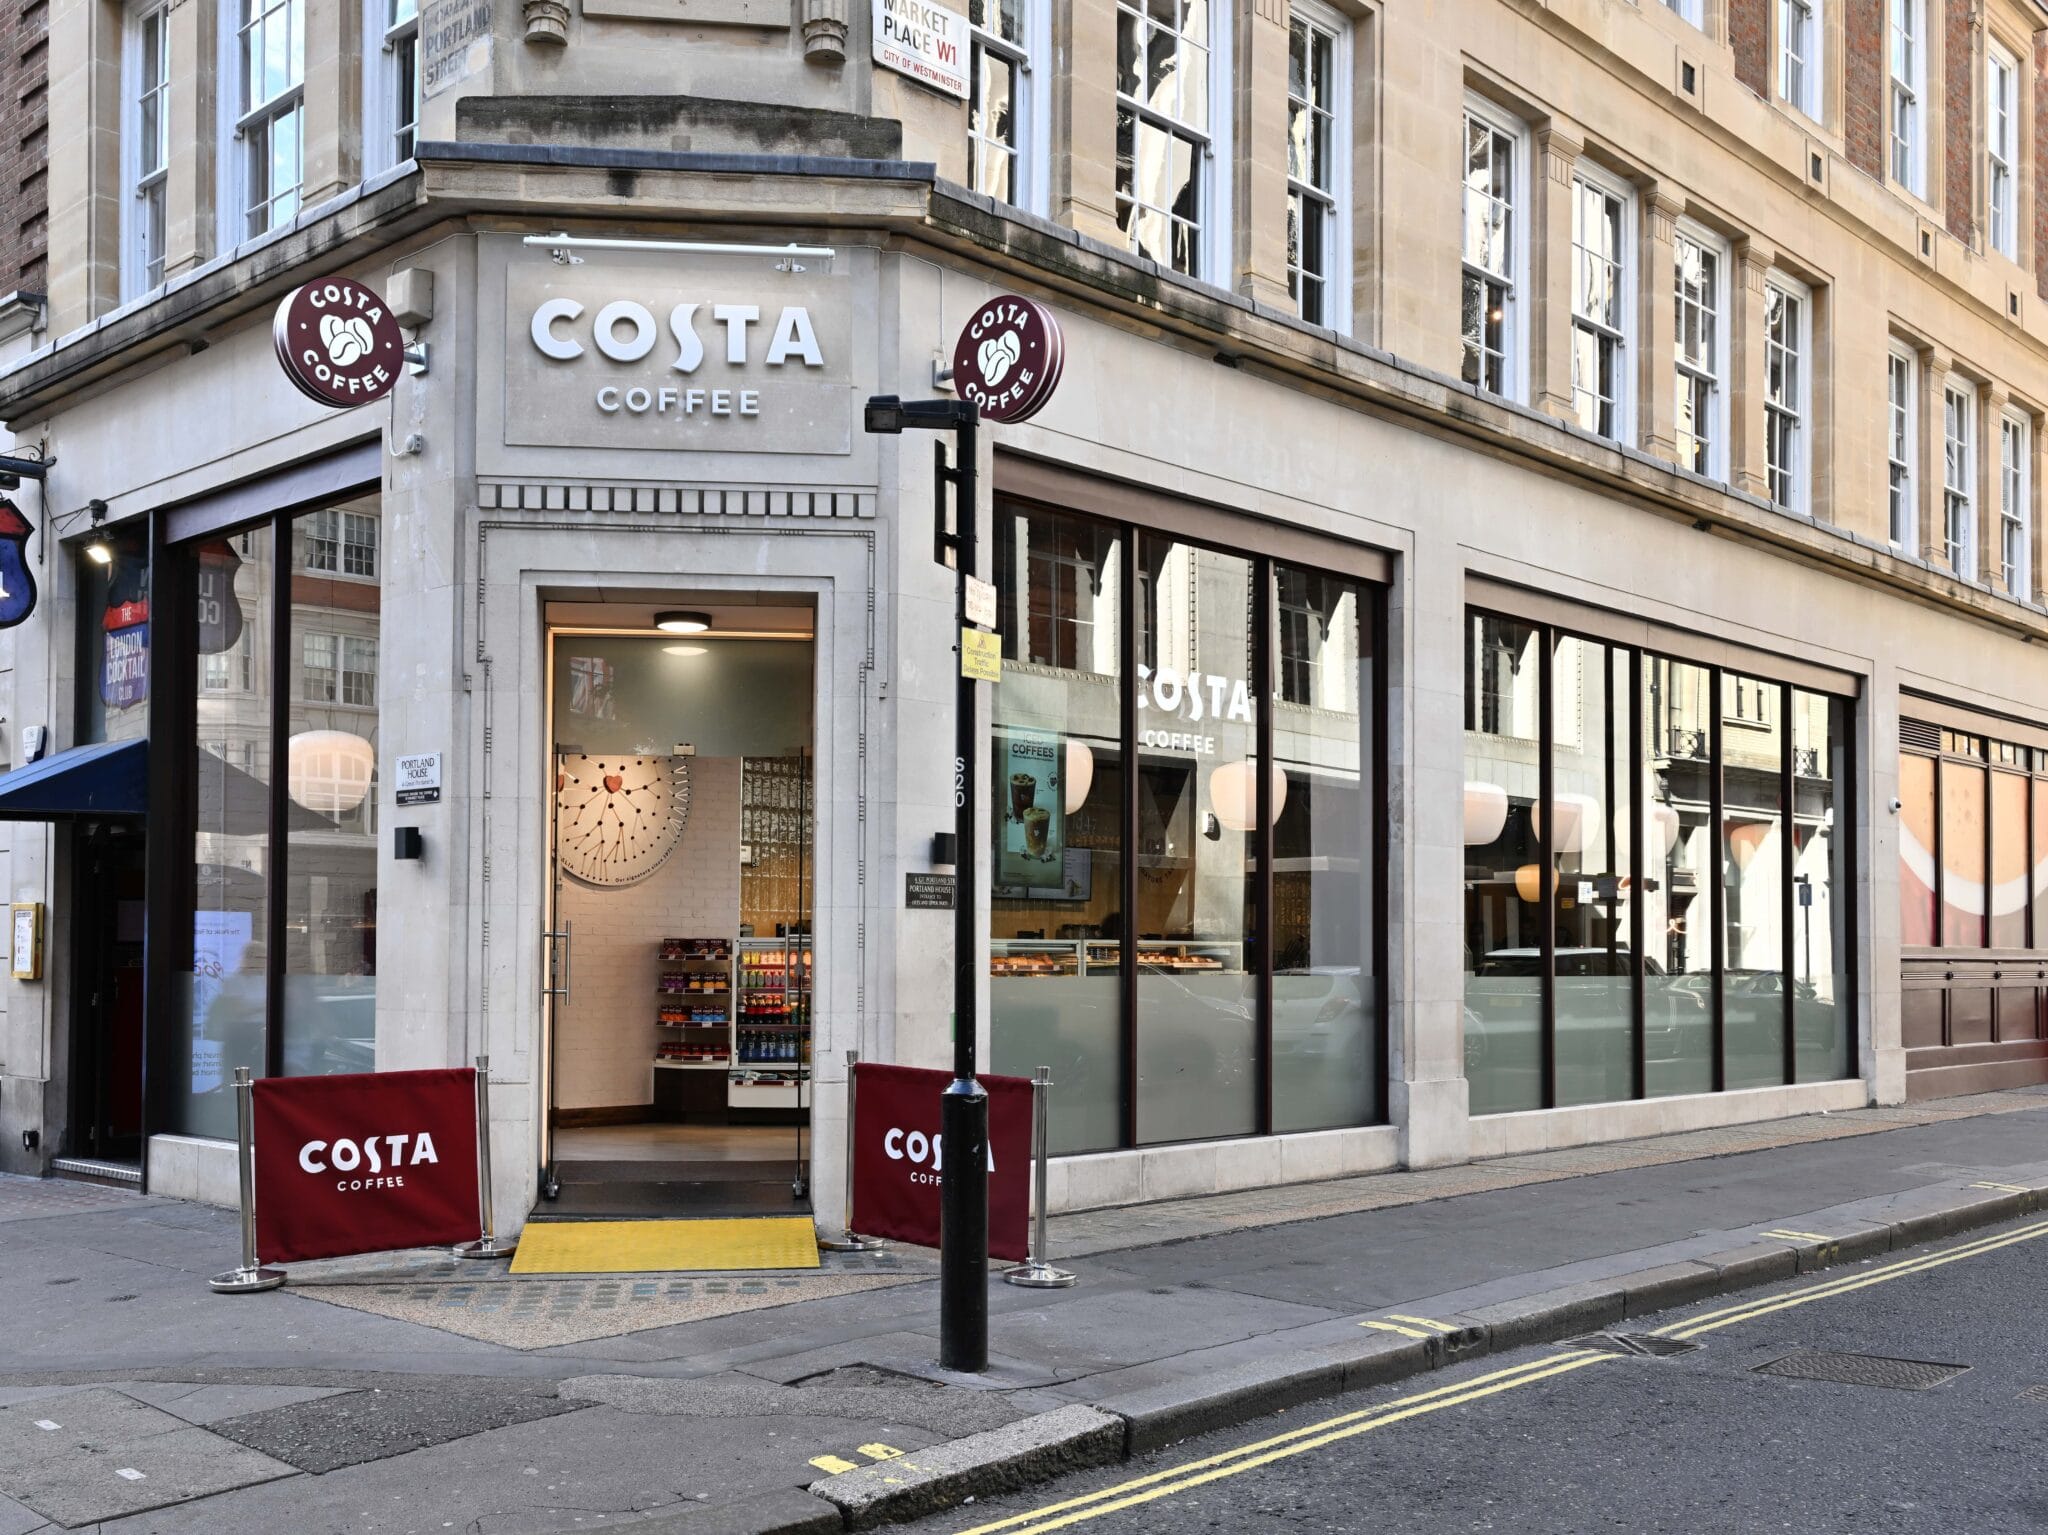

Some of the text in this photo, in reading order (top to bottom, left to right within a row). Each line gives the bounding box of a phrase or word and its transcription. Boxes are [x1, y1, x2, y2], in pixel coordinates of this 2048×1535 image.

[426, 4, 491, 58] PORTLAND
[884, 15, 957, 66] PLACE W1
[883, 49, 962, 92] CITY OF WESTMINSTER
[310, 284, 383, 325] COSTA
[531, 297, 825, 374] COSTA
[970, 303, 1029, 339] COSTA
[303, 349, 390, 395] COFFEE
[597, 386, 760, 414] COFFEE
[965, 368, 1034, 411] COFFEE
[121, 606, 132, 621] THE
[109, 630, 143, 659] LONDON
[106, 653, 145, 684] COCKTAIL
[118, 684, 132, 701] CLUB
[1012, 743, 1054, 758] COFFEES
[1145, 729, 1215, 754] COFFEE
[401, 757, 435, 770] PORTLAND
[407, 768, 428, 779] HOUSE
[910, 884, 935, 893] PORTLAND
[299, 1132, 438, 1174] COSTA
[337, 1176, 404, 1191] COFFEE
[910, 1171, 942, 1187] COFF
